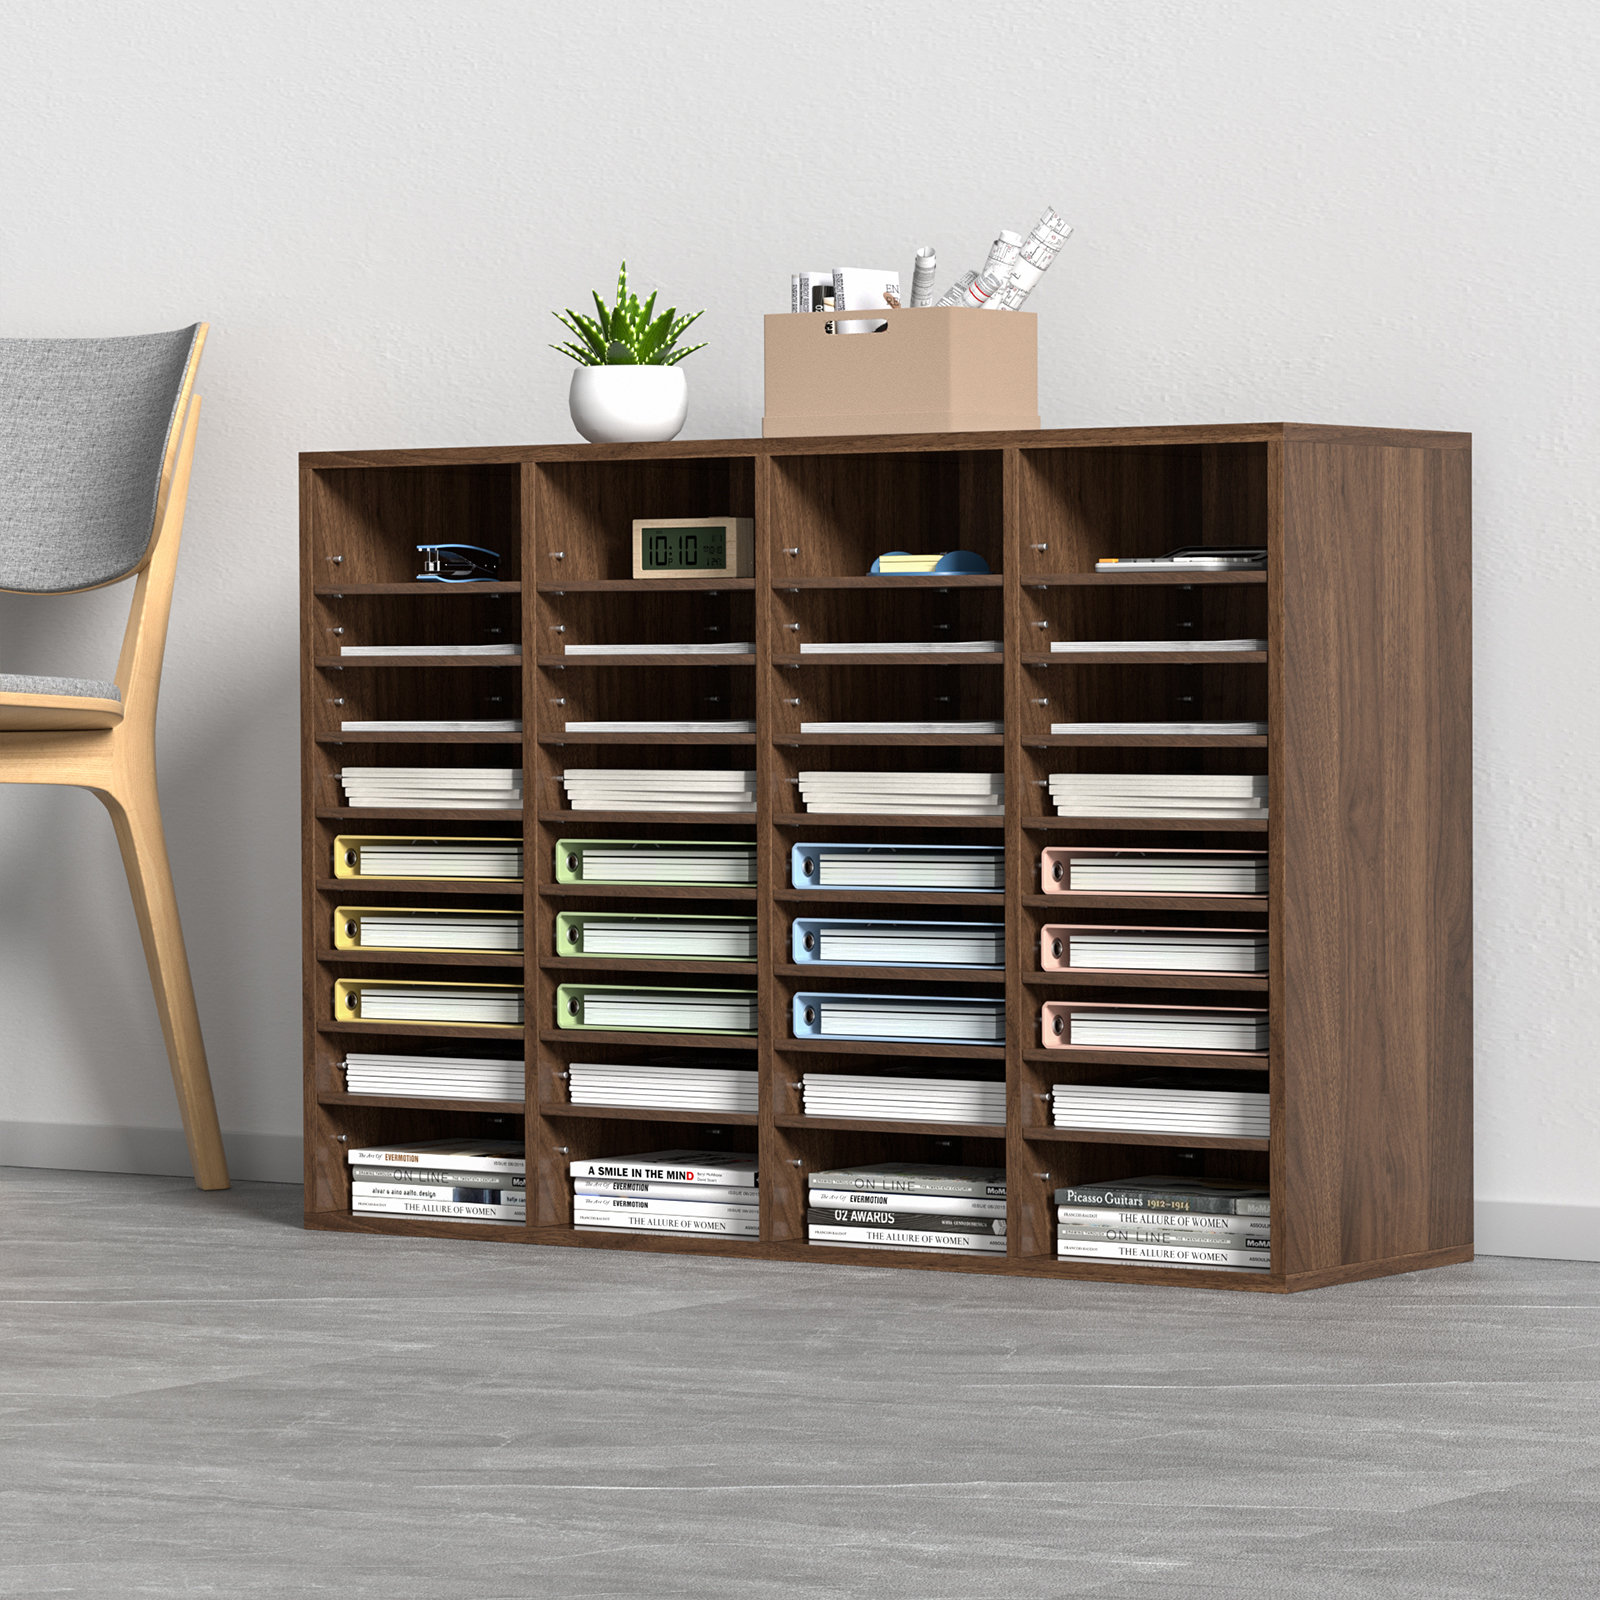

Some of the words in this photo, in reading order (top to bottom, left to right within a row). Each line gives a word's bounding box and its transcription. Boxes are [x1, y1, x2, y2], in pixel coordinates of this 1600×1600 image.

[649, 536, 698, 566] 10:10
[385, 1154, 419, 1162] EVERMOTION
[394, 1169, 412, 1181] ON
[419, 1170, 450, 1184] LINE
[588, 1166, 595, 1176] A
[598, 1166, 628, 1177] SMILE
[632, 1168, 642, 1178] IN
[645, 1169, 664, 1179] THE
[666, 1171, 694, 1180] MIND
[613, 1182, 648, 1192] EVERMOTION
[855, 1178, 876, 1190] ON
[882, 1179, 916, 1192] LINE
[613, 1200, 648, 1208] EVERMOTION
[850, 1194, 888, 1204] EVERMOTION
[1067, 1190, 1102, 1204] Picasso
[1104, 1192, 1143, 1206] Guitars
[404, 1203, 420, 1212] THE
[422, 1205, 454, 1214] ALLURE
[456, 1206, 464, 1214] OF
[466, 1207, 496, 1216] WOMEN
[629, 1216, 646, 1225] THE
[647, 1218, 679, 1228] ALLURE
[681, 1220, 690, 1228] OF
[693, 1221, 726, 1230] WOMEN
[850, 1210, 895, 1224] AWARDS
[1119, 1212, 1138, 1223] THE
[1140, 1214, 1176, 1226] ALLURE
[1178, 1216, 1190, 1226] OF
[1192, 1217, 1228, 1228] WOMEN
[866, 1232, 884, 1240] THE
[886, 1233, 920, 1242] ALLURE
[922, 1235, 932, 1244] OF
[934, 1236, 970, 1246] WOMEN
[1106, 1230, 1128, 1240] ON
[1136, 1231, 1170, 1244] LINE
[1118, 1246, 1138, 1256] THE
[1140, 1248, 1175, 1259] ALLURE
[1177, 1250, 1190, 1260] OF
[1192, 1251, 1228, 1262] WOMEN
